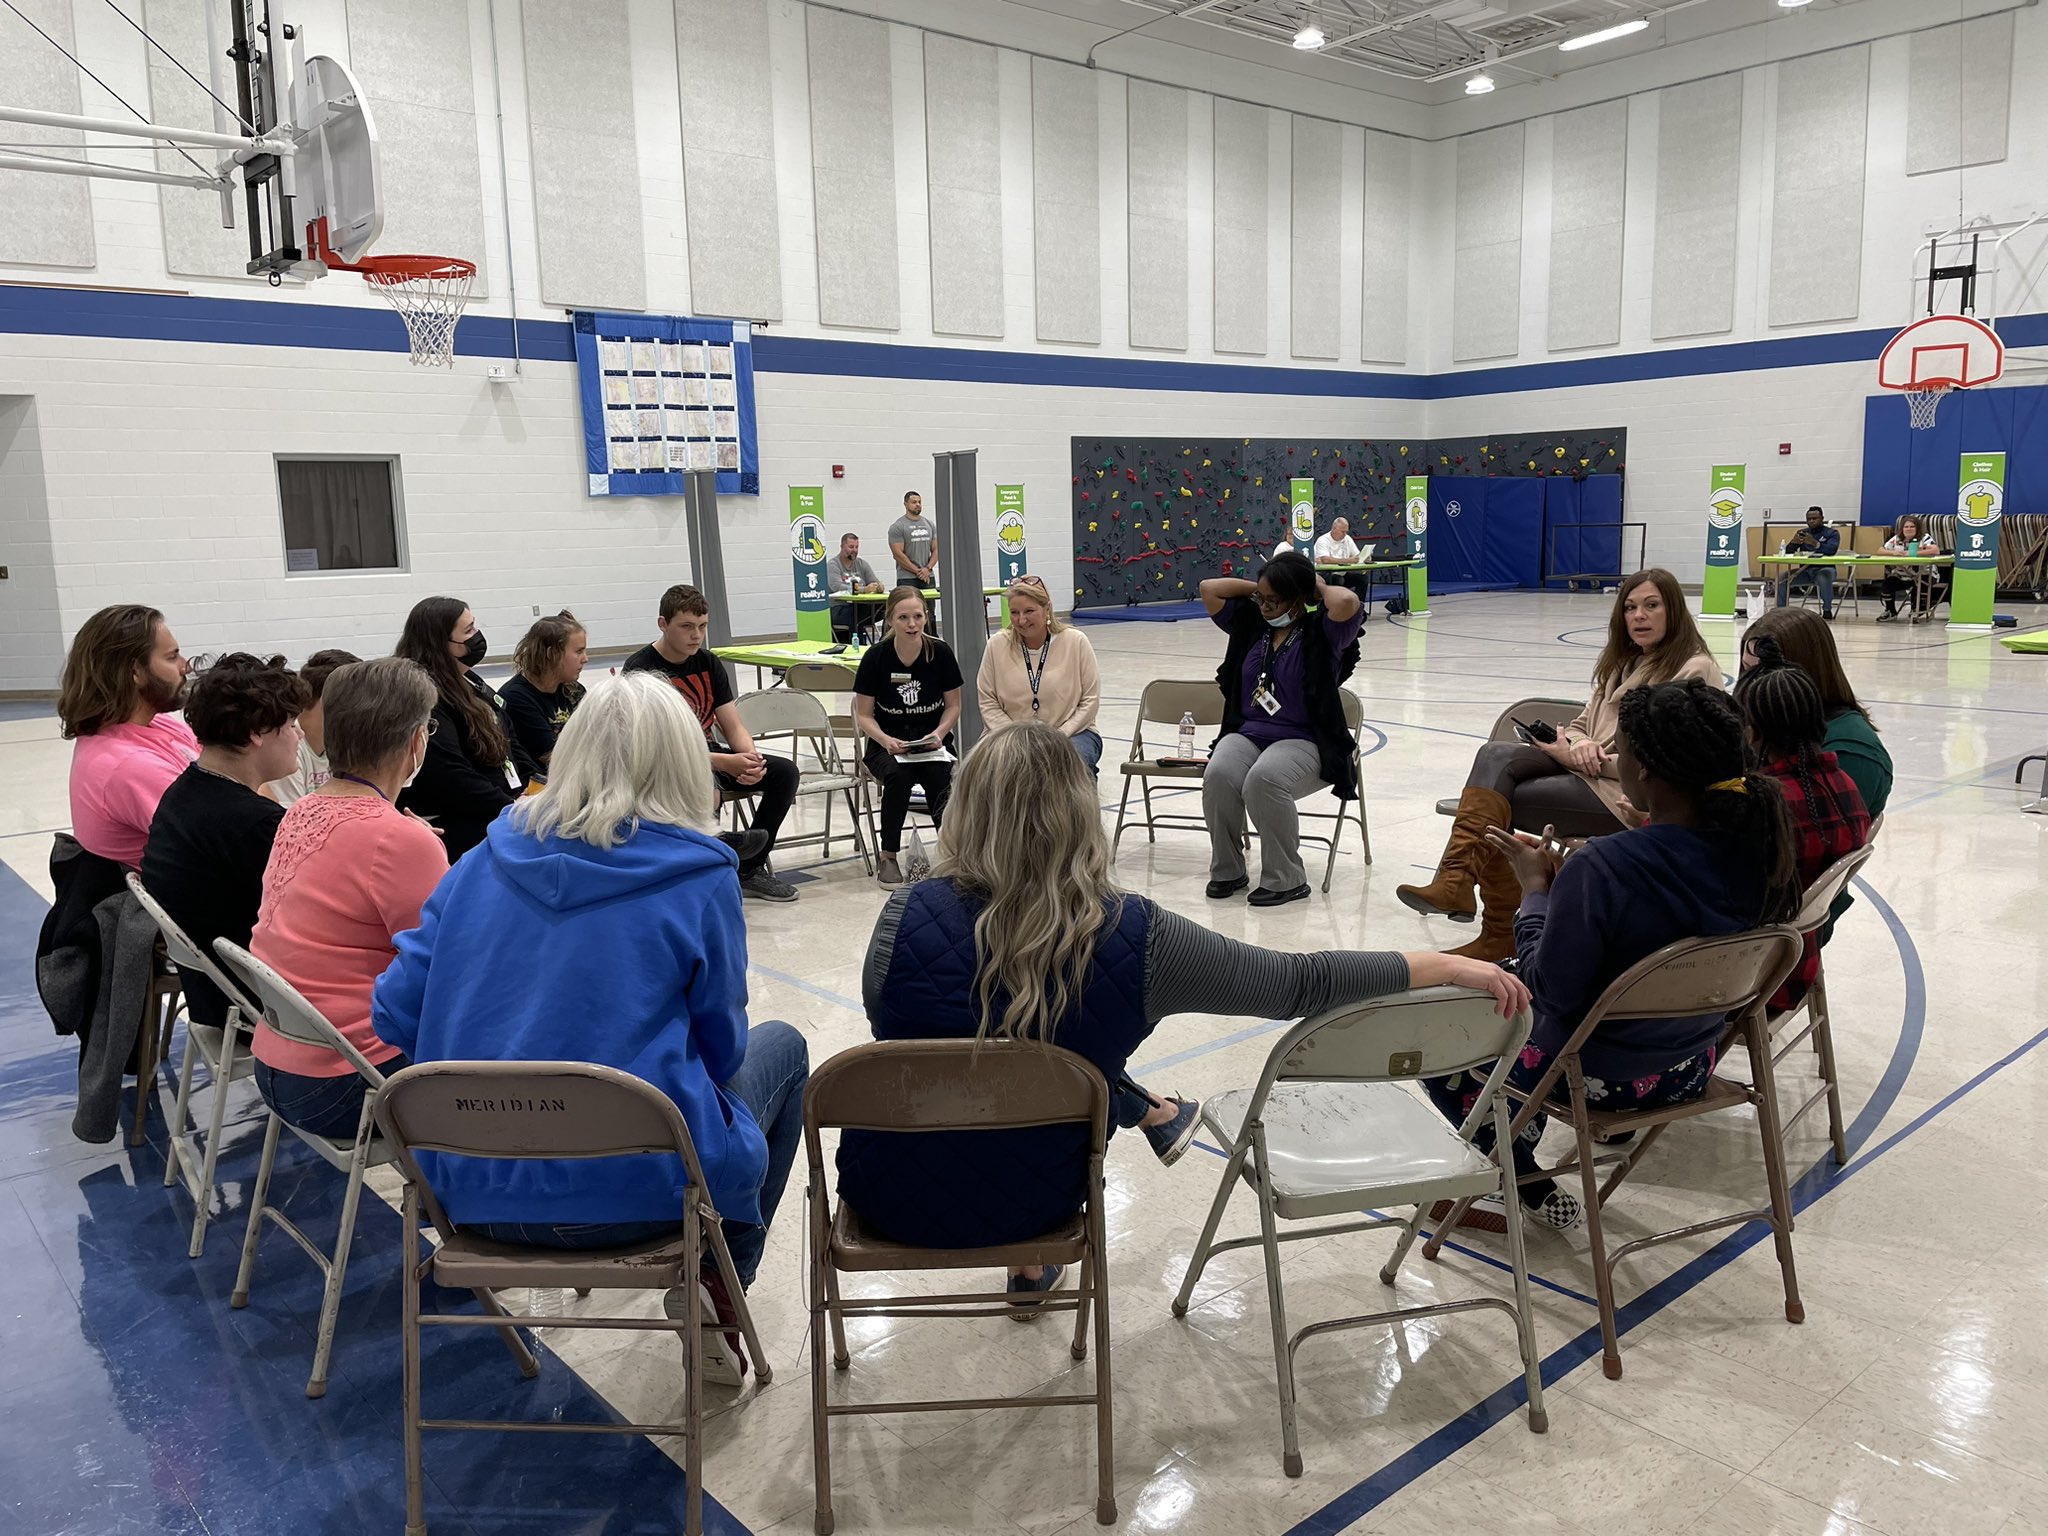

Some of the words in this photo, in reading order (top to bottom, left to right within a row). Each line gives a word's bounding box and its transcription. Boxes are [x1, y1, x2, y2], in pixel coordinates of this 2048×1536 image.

[1709, 549, 1735, 557] realityU
[1960, 550, 1992, 559] realityU
[800, 590, 826, 599] realityU
[456, 1098, 565, 1111] MERIDIAN
